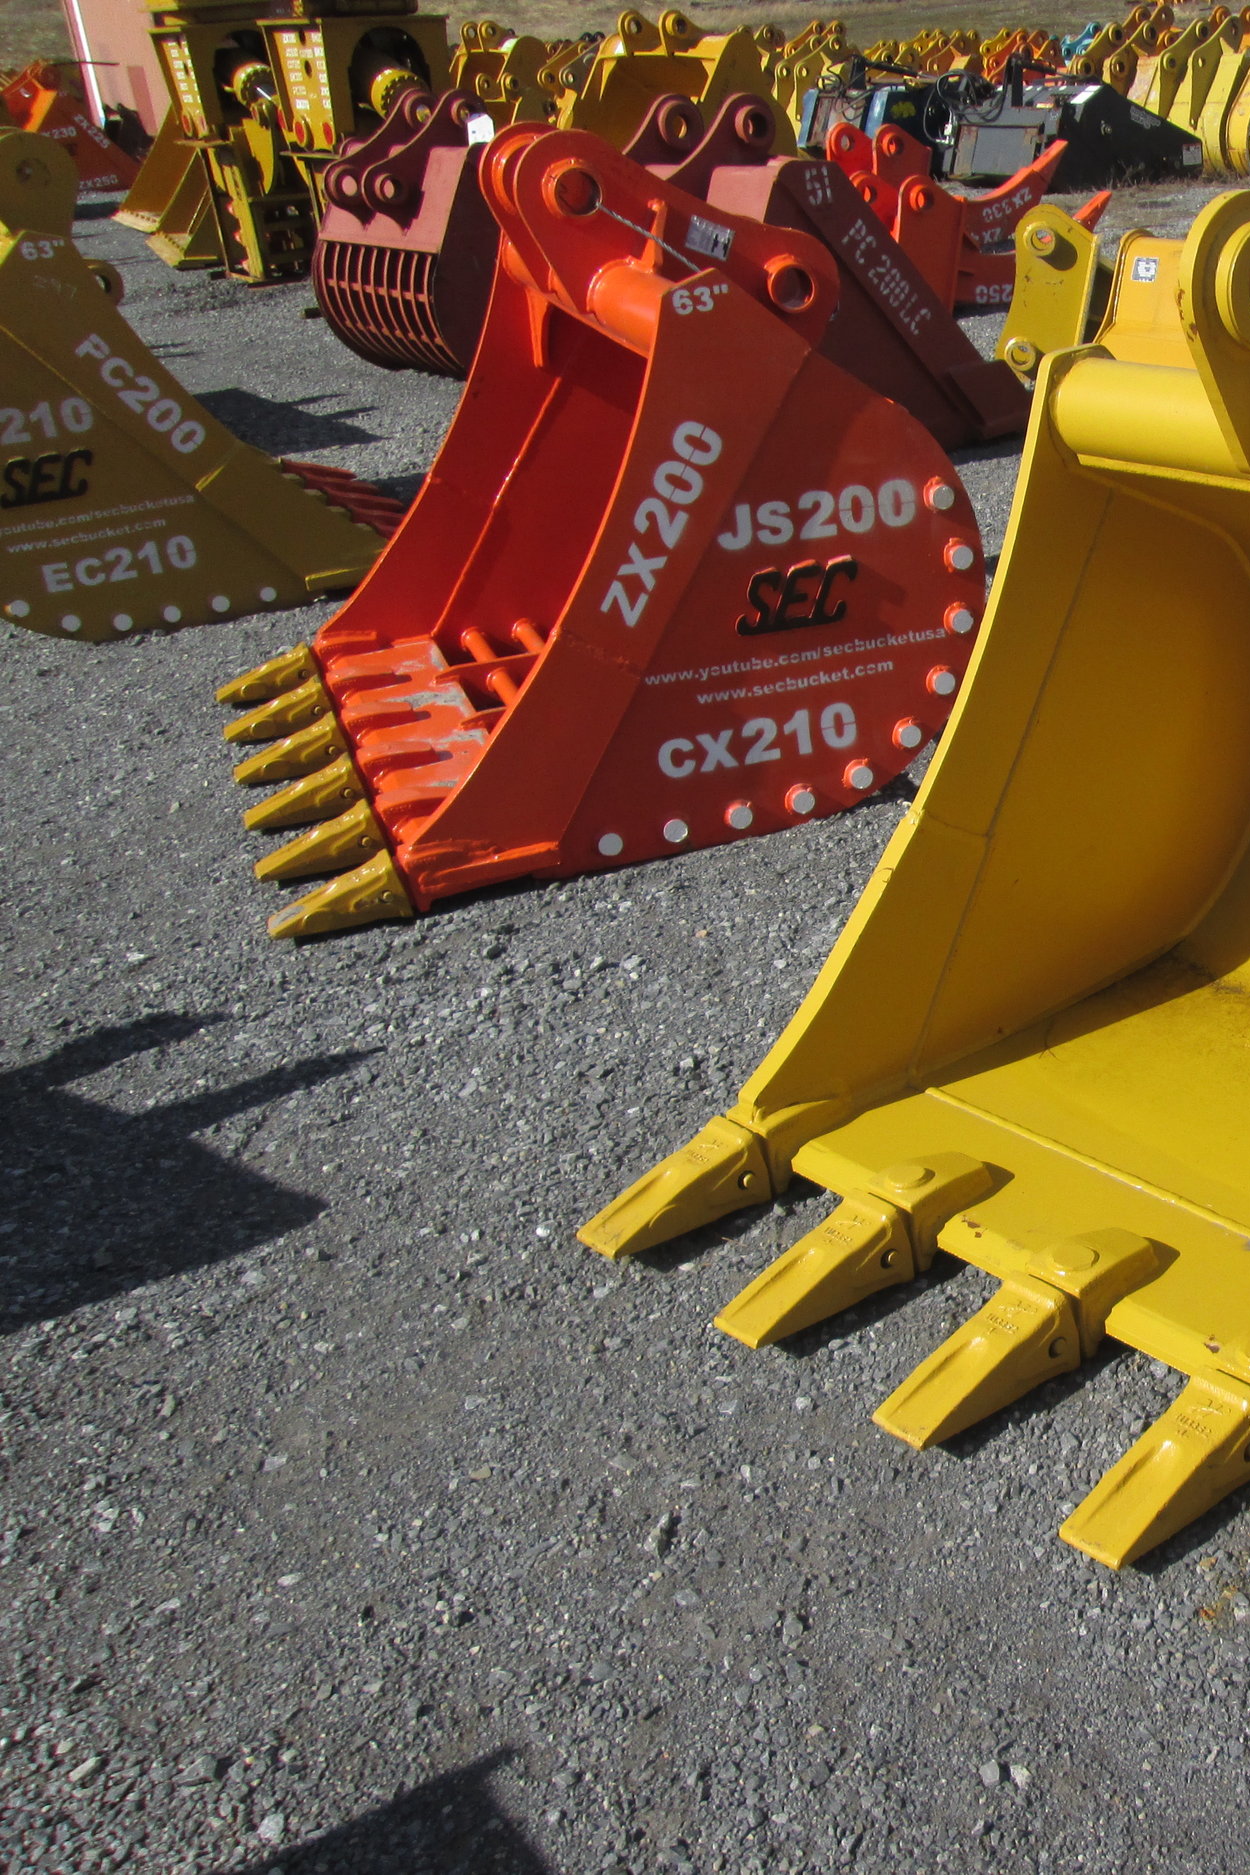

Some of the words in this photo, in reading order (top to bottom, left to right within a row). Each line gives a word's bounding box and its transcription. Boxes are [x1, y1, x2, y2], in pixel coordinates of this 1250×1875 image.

[20, 239, 65, 261] 63"
[672, 283, 729, 316] 63"
[75, 333, 206, 454] PC200
[0, 448, 93, 509] SEC
[8, 518, 167, 553] www.secbucket.com
[600, 420, 722, 628] ZX200
[717, 478, 916, 550] JS200
[42, 535, 197, 593] EC210
[735, 554, 859, 636] SEC
[645, 627, 947, 686] www.youtube.com/secbucketusa
[697, 658, 894, 704] www.secbucket.com
[657, 701, 857, 778] CX210
